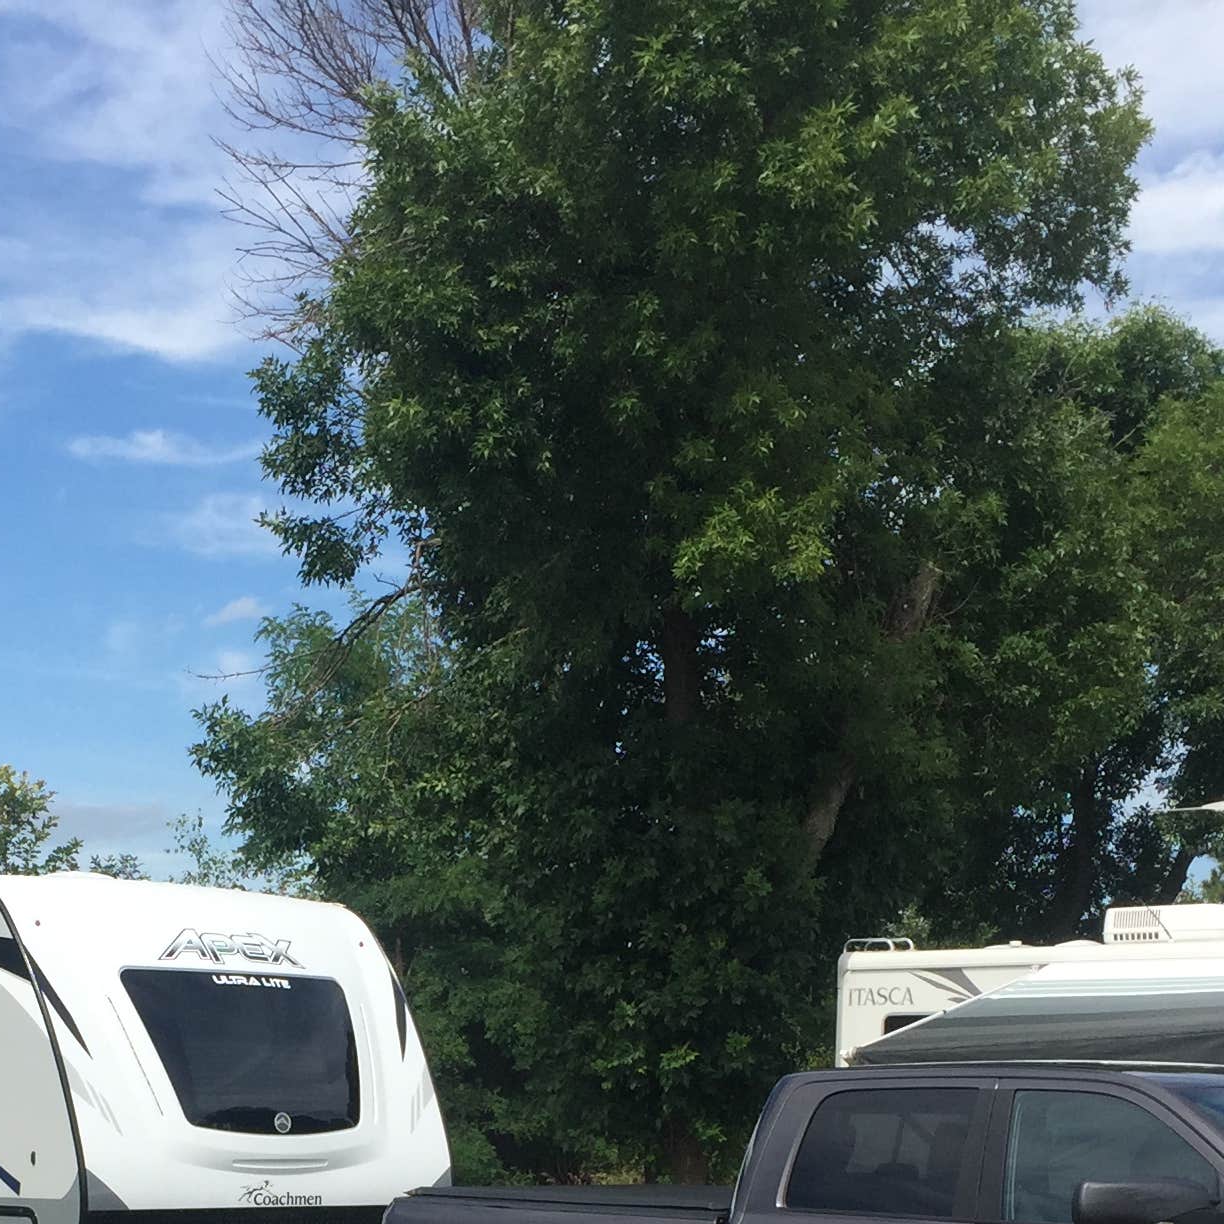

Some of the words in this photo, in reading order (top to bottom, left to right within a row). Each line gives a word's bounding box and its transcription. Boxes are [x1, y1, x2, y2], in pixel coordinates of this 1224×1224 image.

[157, 927, 307, 970] APEX
[212, 974, 261, 987] ULTRA
[261, 977, 291, 989] LITE
[848, 986, 914, 1007] ITASCA
[253, 1191, 323, 1206] Coachmen
